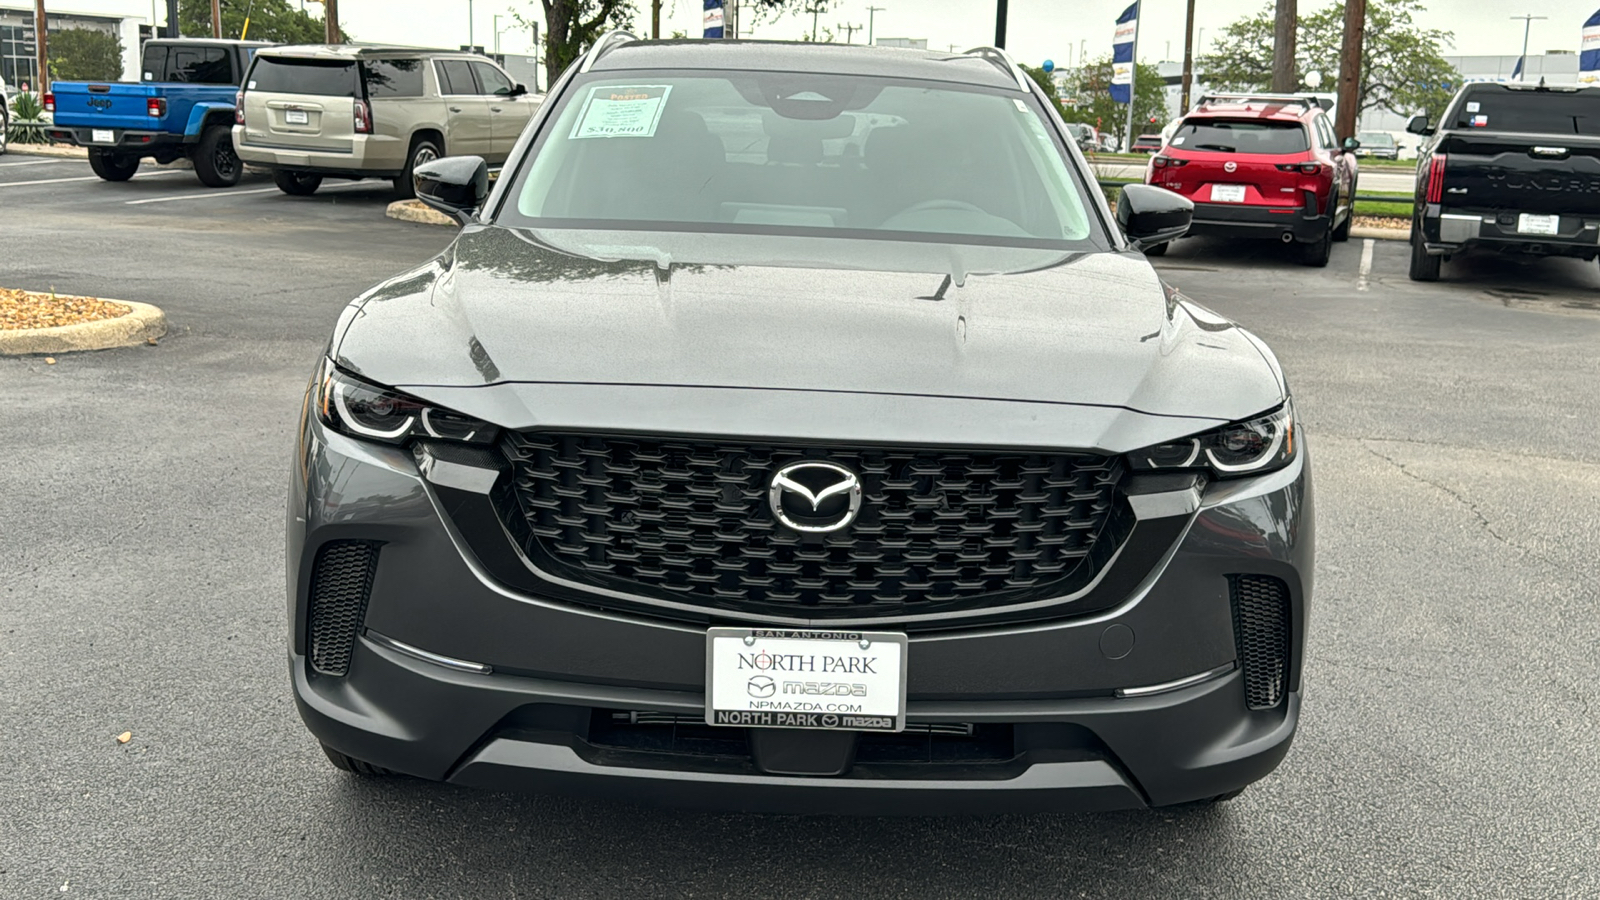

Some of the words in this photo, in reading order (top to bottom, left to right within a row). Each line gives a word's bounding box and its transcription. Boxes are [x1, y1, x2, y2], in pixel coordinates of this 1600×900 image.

[87, 97, 113, 109] Jeep
[755, 630, 785, 638] SAN
[792, 631, 859, 640] ANTONIO
[737, 652, 815, 673] NORTH
[822, 656, 878, 675] PARK
[782, 680, 867, 697] mazda
[749, 701, 862, 713] NPMAZDA.COM
[718, 711, 772, 725] NORTH
[776, 713, 818, 727] PARK
